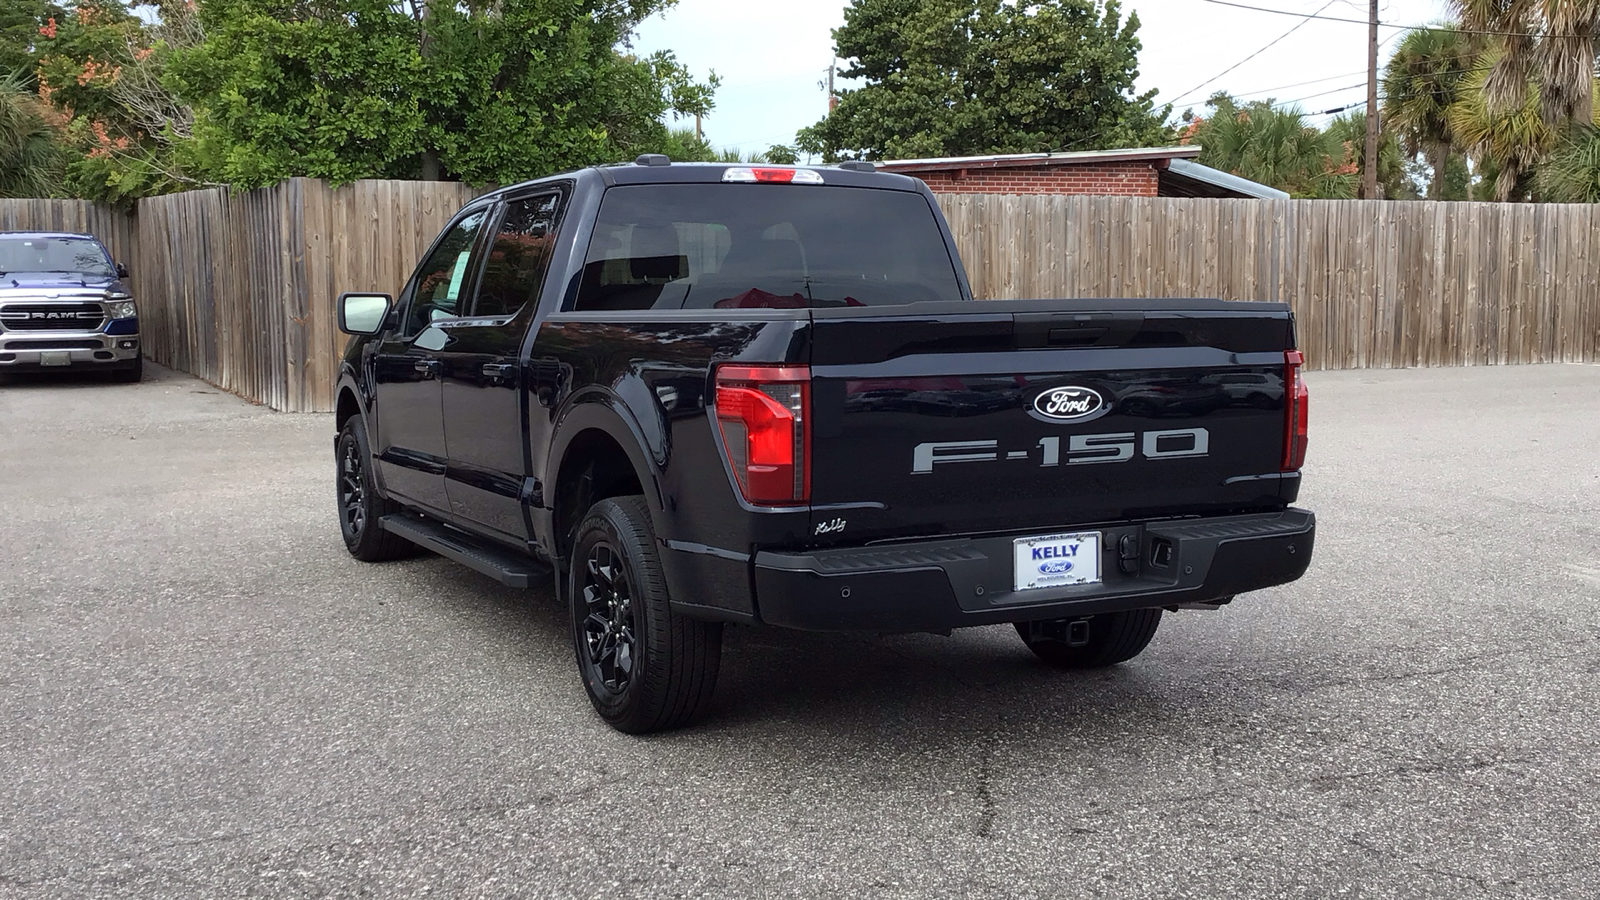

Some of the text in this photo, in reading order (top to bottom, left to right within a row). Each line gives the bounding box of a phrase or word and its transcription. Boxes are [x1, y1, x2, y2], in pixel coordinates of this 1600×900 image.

[1046, 390, 1090, 413] Ford
[910, 427, 1209, 475] F-150
[814, 517, 847, 536] Kelly
[1031, 543, 1080, 560] KELLY
[1045, 561, 1068, 573] Ford
